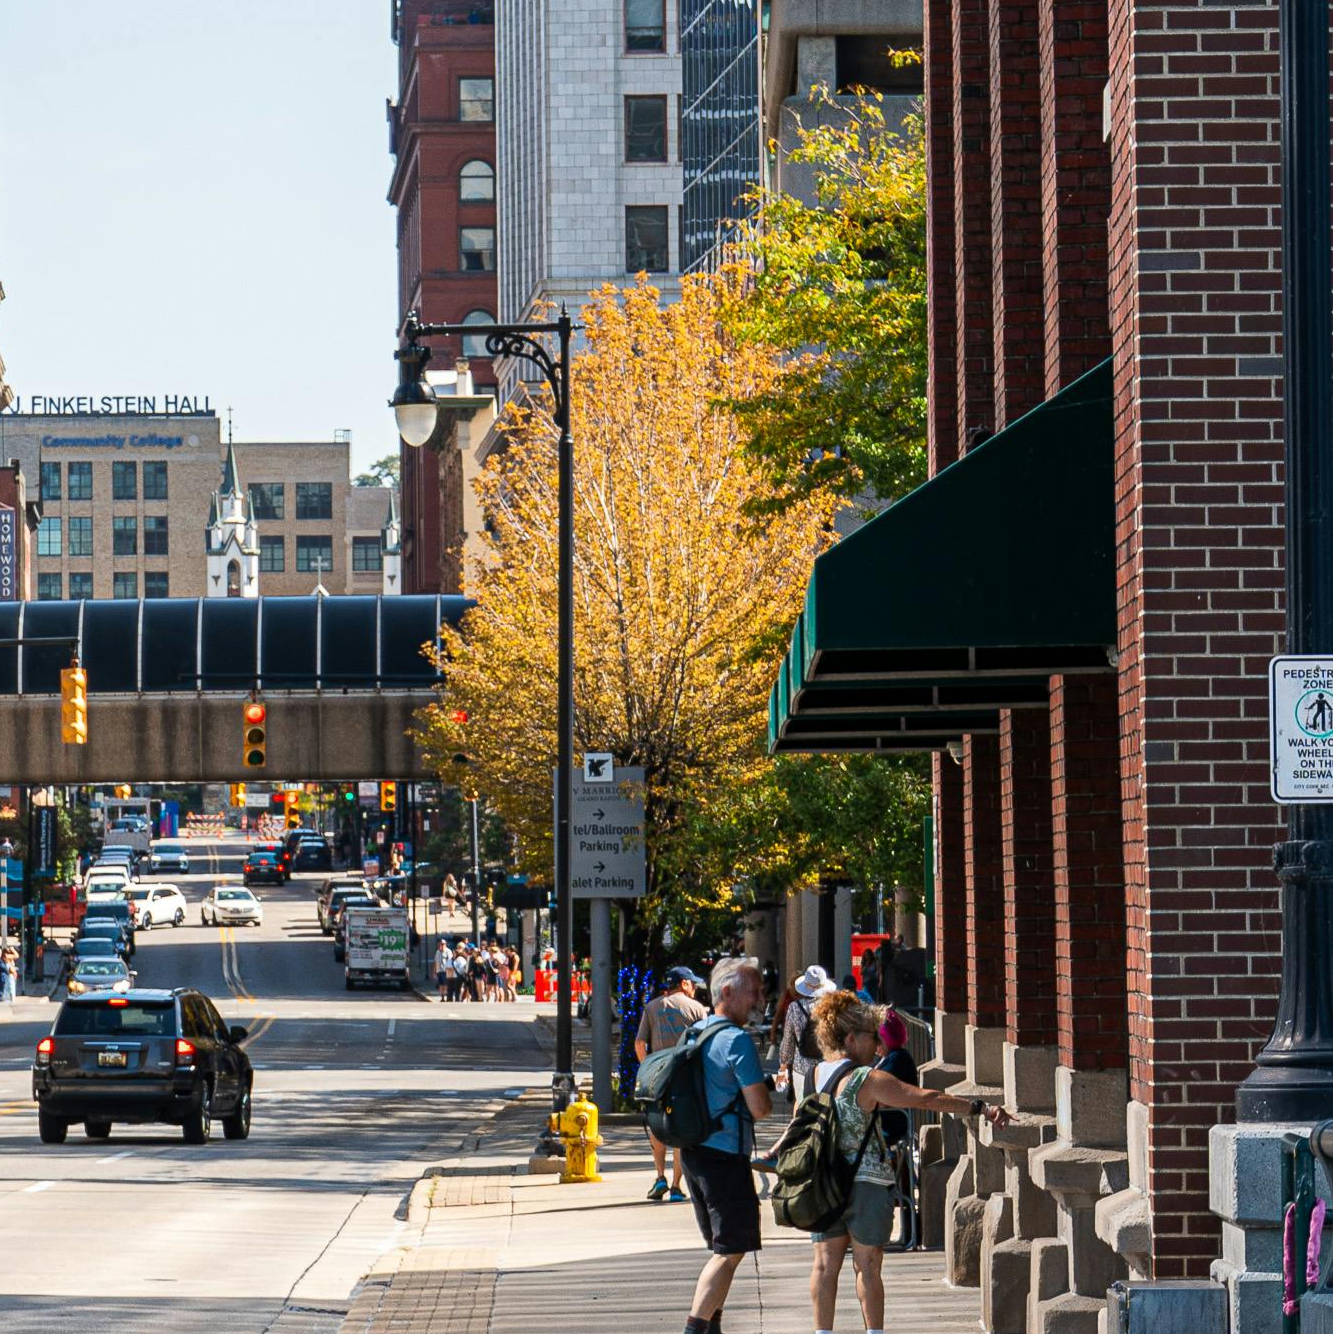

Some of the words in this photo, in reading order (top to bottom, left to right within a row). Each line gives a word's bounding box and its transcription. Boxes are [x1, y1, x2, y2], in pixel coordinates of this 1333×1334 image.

[31, 395, 156, 415] FINKELSTEIN
[165, 395, 211, 415] HALL
[0, 514, 12, 597] HOMEWOOD
[1302, 679, 1333, 689] ZONE
[1288, 738, 1318, 748] WALK
[1300, 759, 1316, 768] ON
[1318, 759, 1333, 768] TH
[573, 824, 640, 836] tel/Ballroom
[580, 841, 619, 854] Parking
[571, 876, 592, 888] alet
[595, 877, 634, 890] Parking
